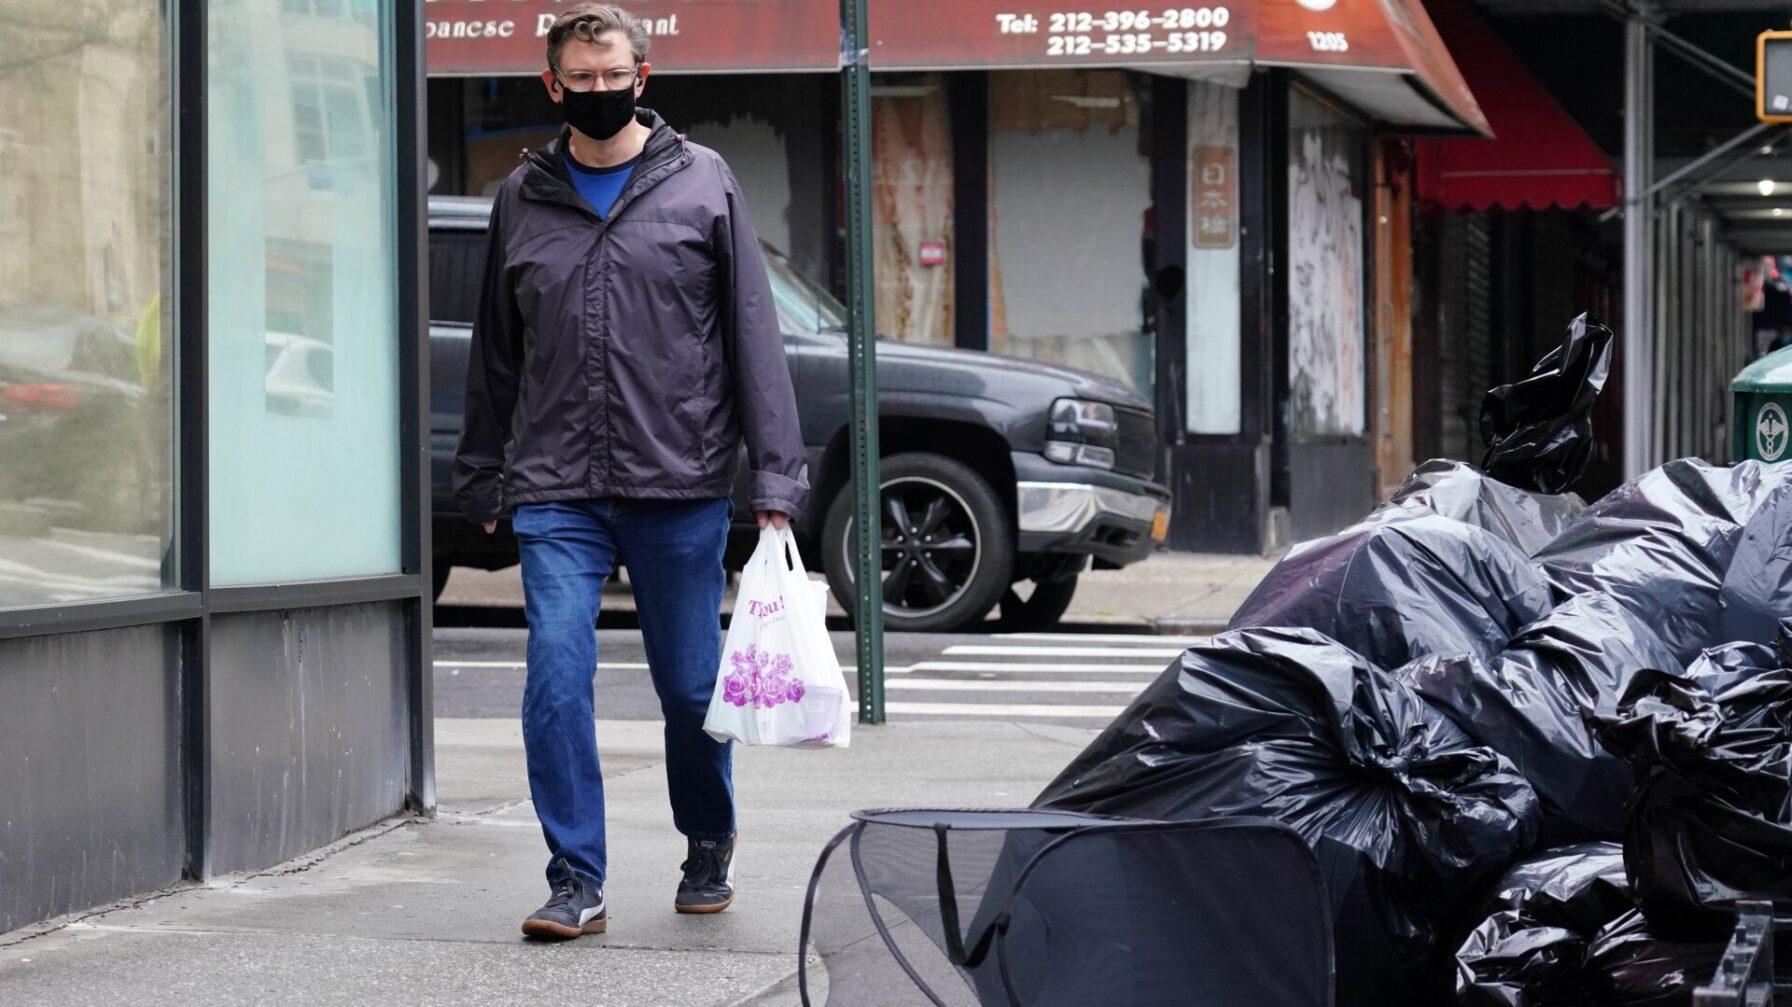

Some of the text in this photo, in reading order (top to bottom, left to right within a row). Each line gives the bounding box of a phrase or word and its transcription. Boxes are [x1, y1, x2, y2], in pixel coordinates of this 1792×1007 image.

[996, 7, 1230, 33] Tel: 212-396-2800
[1046, 31, 1227, 56] 212-535-5319
[1306, 31, 1349, 52] 1205
